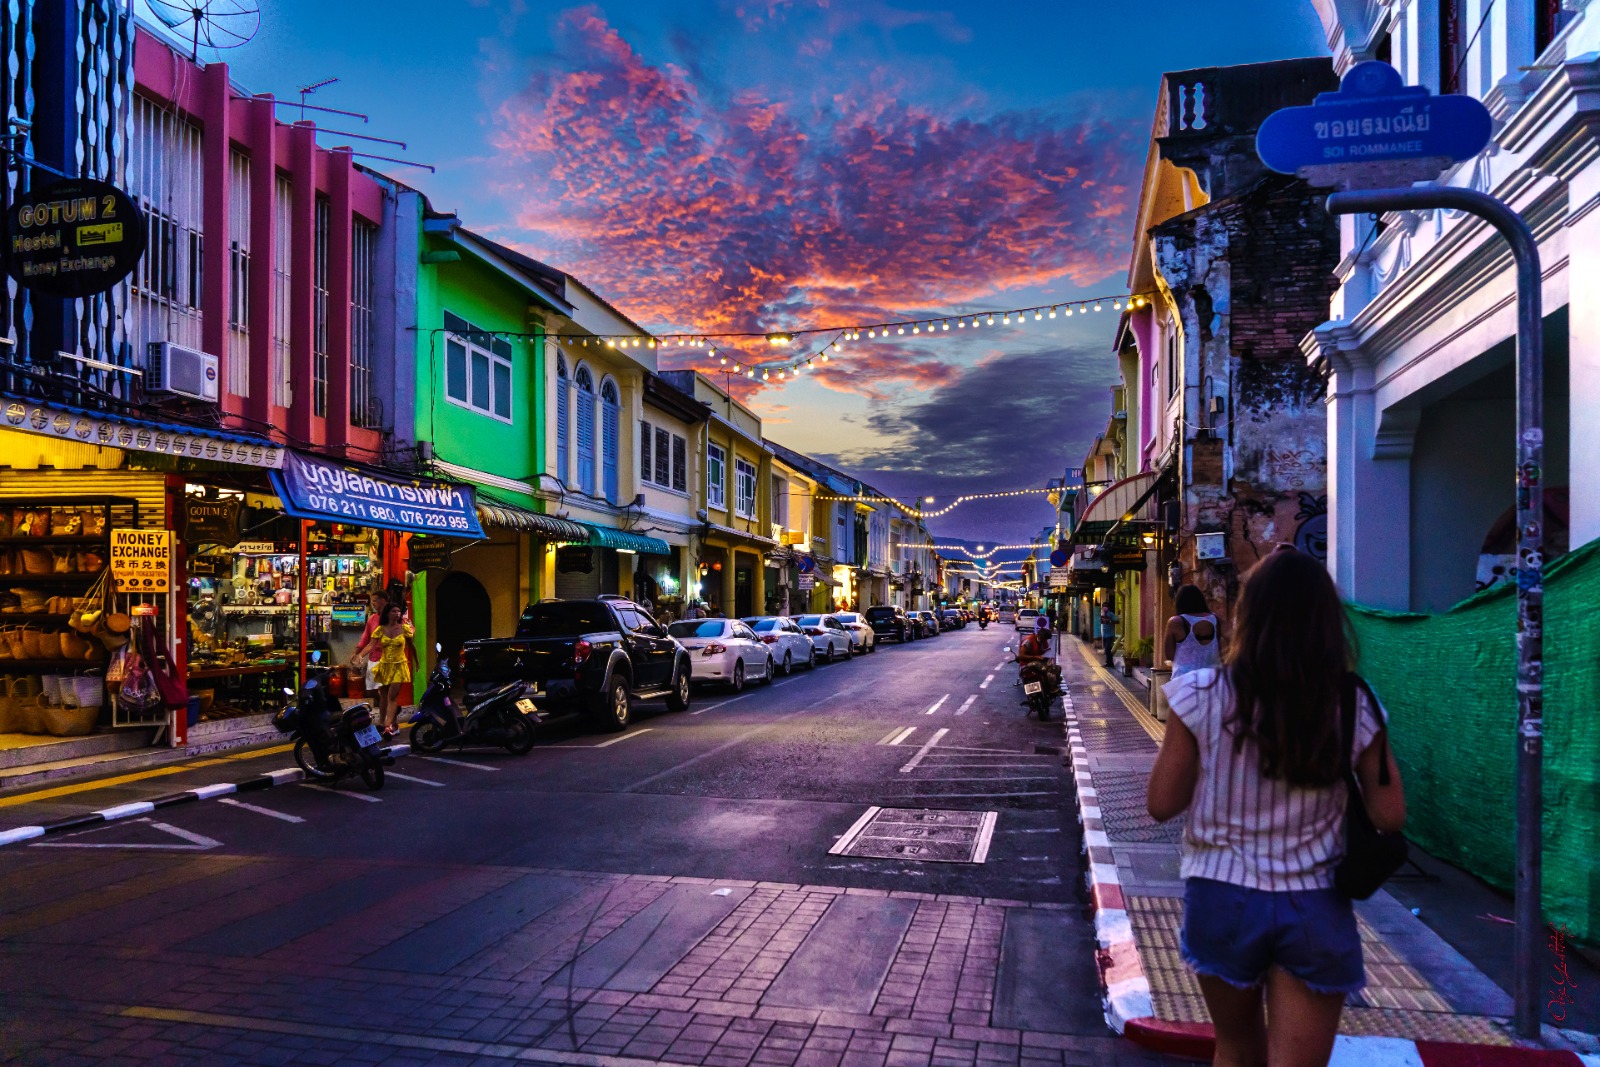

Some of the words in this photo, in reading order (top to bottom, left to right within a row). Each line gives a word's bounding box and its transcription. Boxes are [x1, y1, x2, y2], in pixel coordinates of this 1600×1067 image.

[1314, 105, 1430, 139] ซอยรมณีย์
[1323, 147, 1345, 159] SOI
[1350, 140, 1423, 156] ROMMANEE
[19, 197, 97, 228] GOTUM
[102, 195, 116, 219] 2
[13, 229, 61, 254] Hostel
[23, 258, 58, 277] Money
[60, 253, 116, 271] Exchange
[190, 506, 220, 516] GOTUM
[309, 494, 339, 512] 076
[343, 498, 366, 517] 211
[401, 511, 424, 525] 076
[427, 514, 447, 527] 223
[449, 517, 469, 529] 955
[117, 533, 163, 545] MONEY
[112, 546, 168, 558] EXCHANGE
